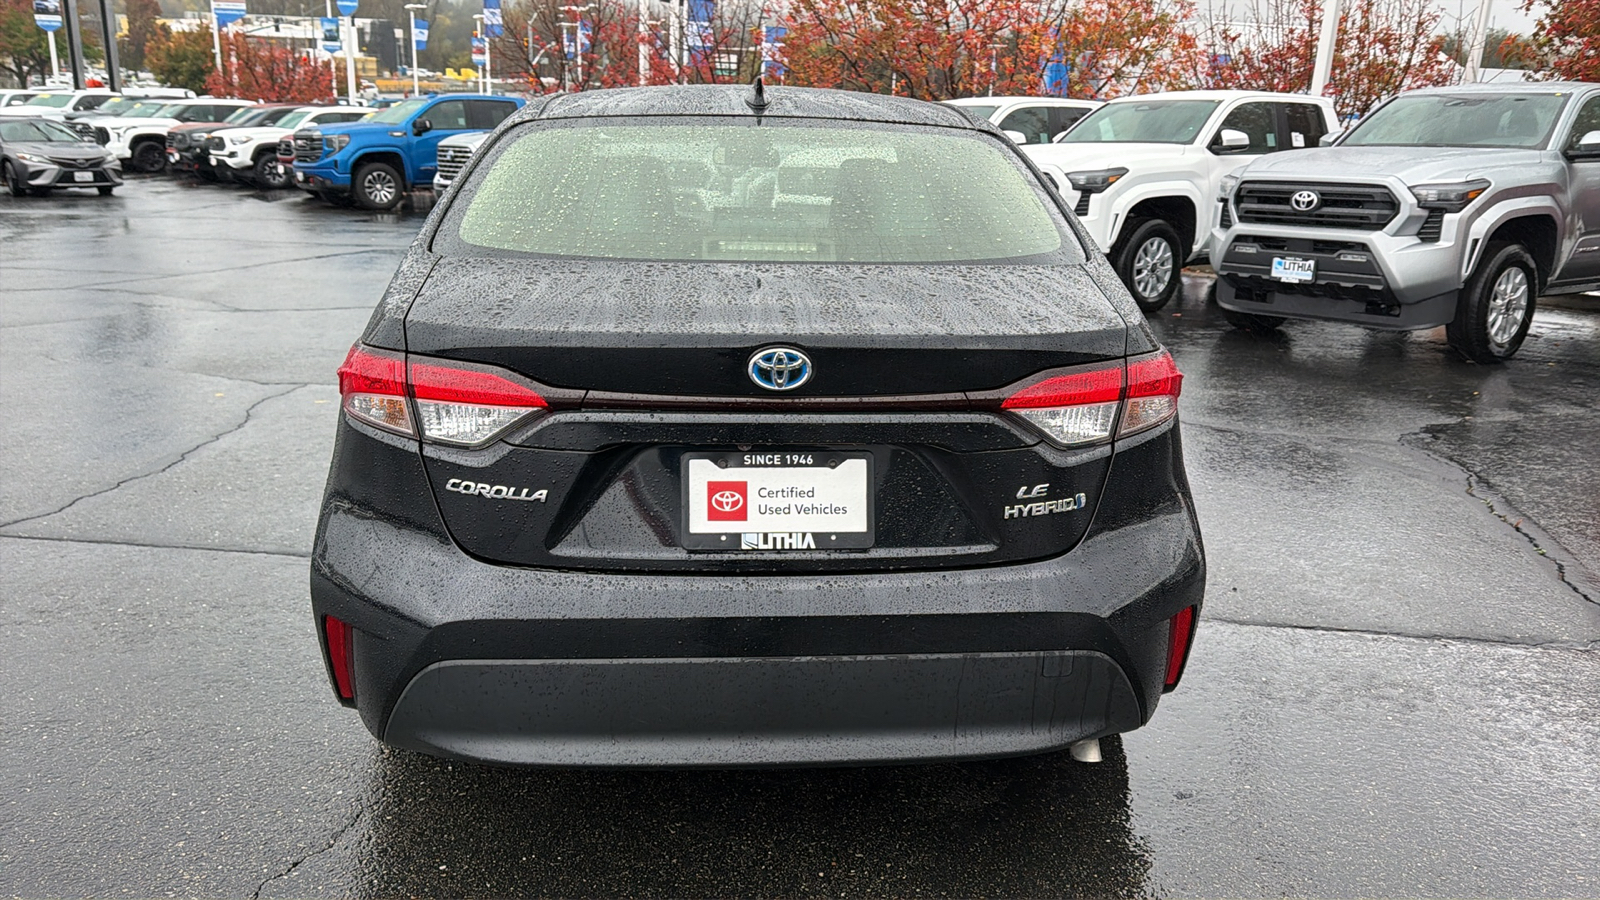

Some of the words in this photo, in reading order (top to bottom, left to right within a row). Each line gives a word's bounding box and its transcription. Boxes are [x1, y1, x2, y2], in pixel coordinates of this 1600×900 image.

[1283, 261, 1313, 272] LITHIA
[743, 454, 781, 465] SINCE
[785, 454, 814, 465] 1946
[445, 478, 549, 503] COROLLA
[757, 487, 815, 498] Certified
[1016, 483, 1050, 499] LE
[757, 503, 791, 515] Used
[794, 503, 848, 515] Vehicles
[1004, 497, 1074, 519] HYBRID
[757, 532, 816, 549] LITHIA
